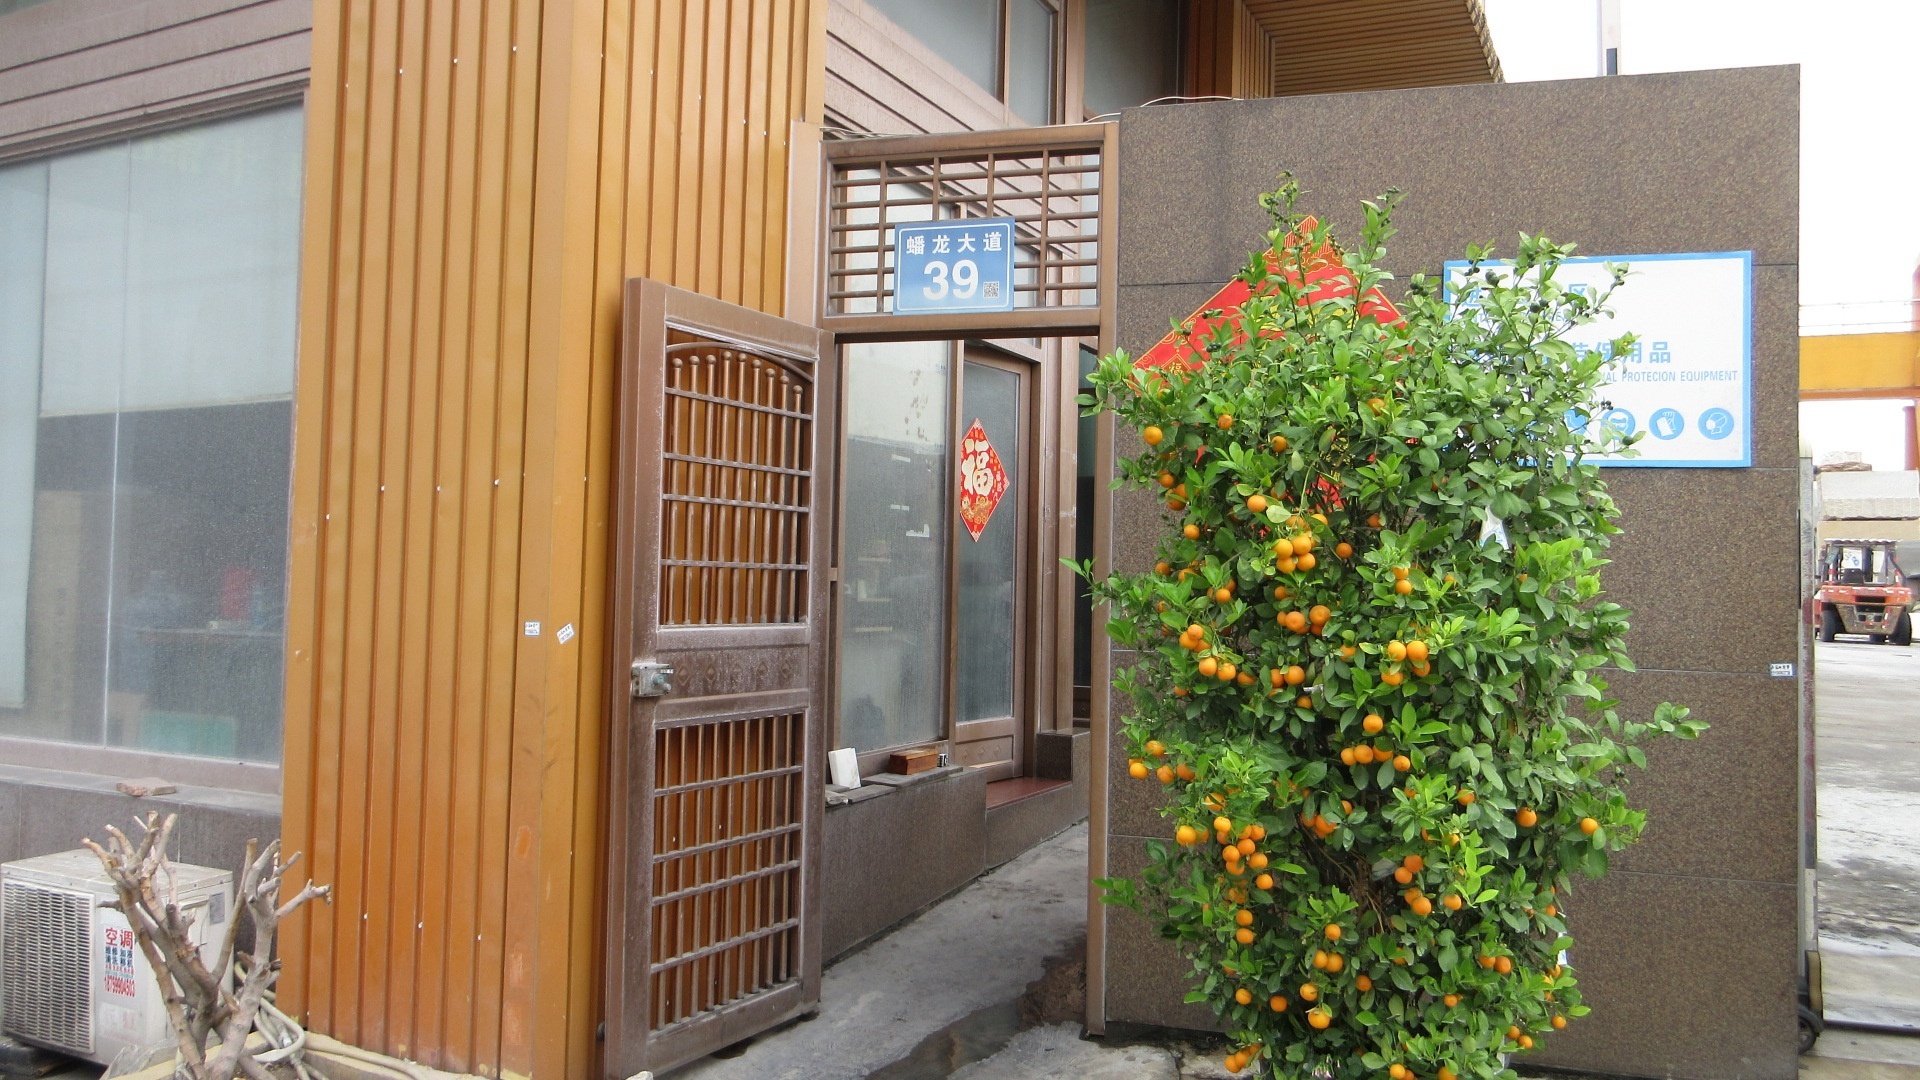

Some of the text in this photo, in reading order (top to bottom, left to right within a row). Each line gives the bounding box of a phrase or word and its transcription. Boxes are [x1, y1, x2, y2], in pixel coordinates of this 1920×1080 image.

[906, 231, 1003, 255] 蟠龙大道
[922, 259, 979, 300] 39
[1621, 371, 1676, 383] PROTECION
[1680, 370, 1739, 382] EQUIPMENT
[105, 926, 134, 950] 空调
